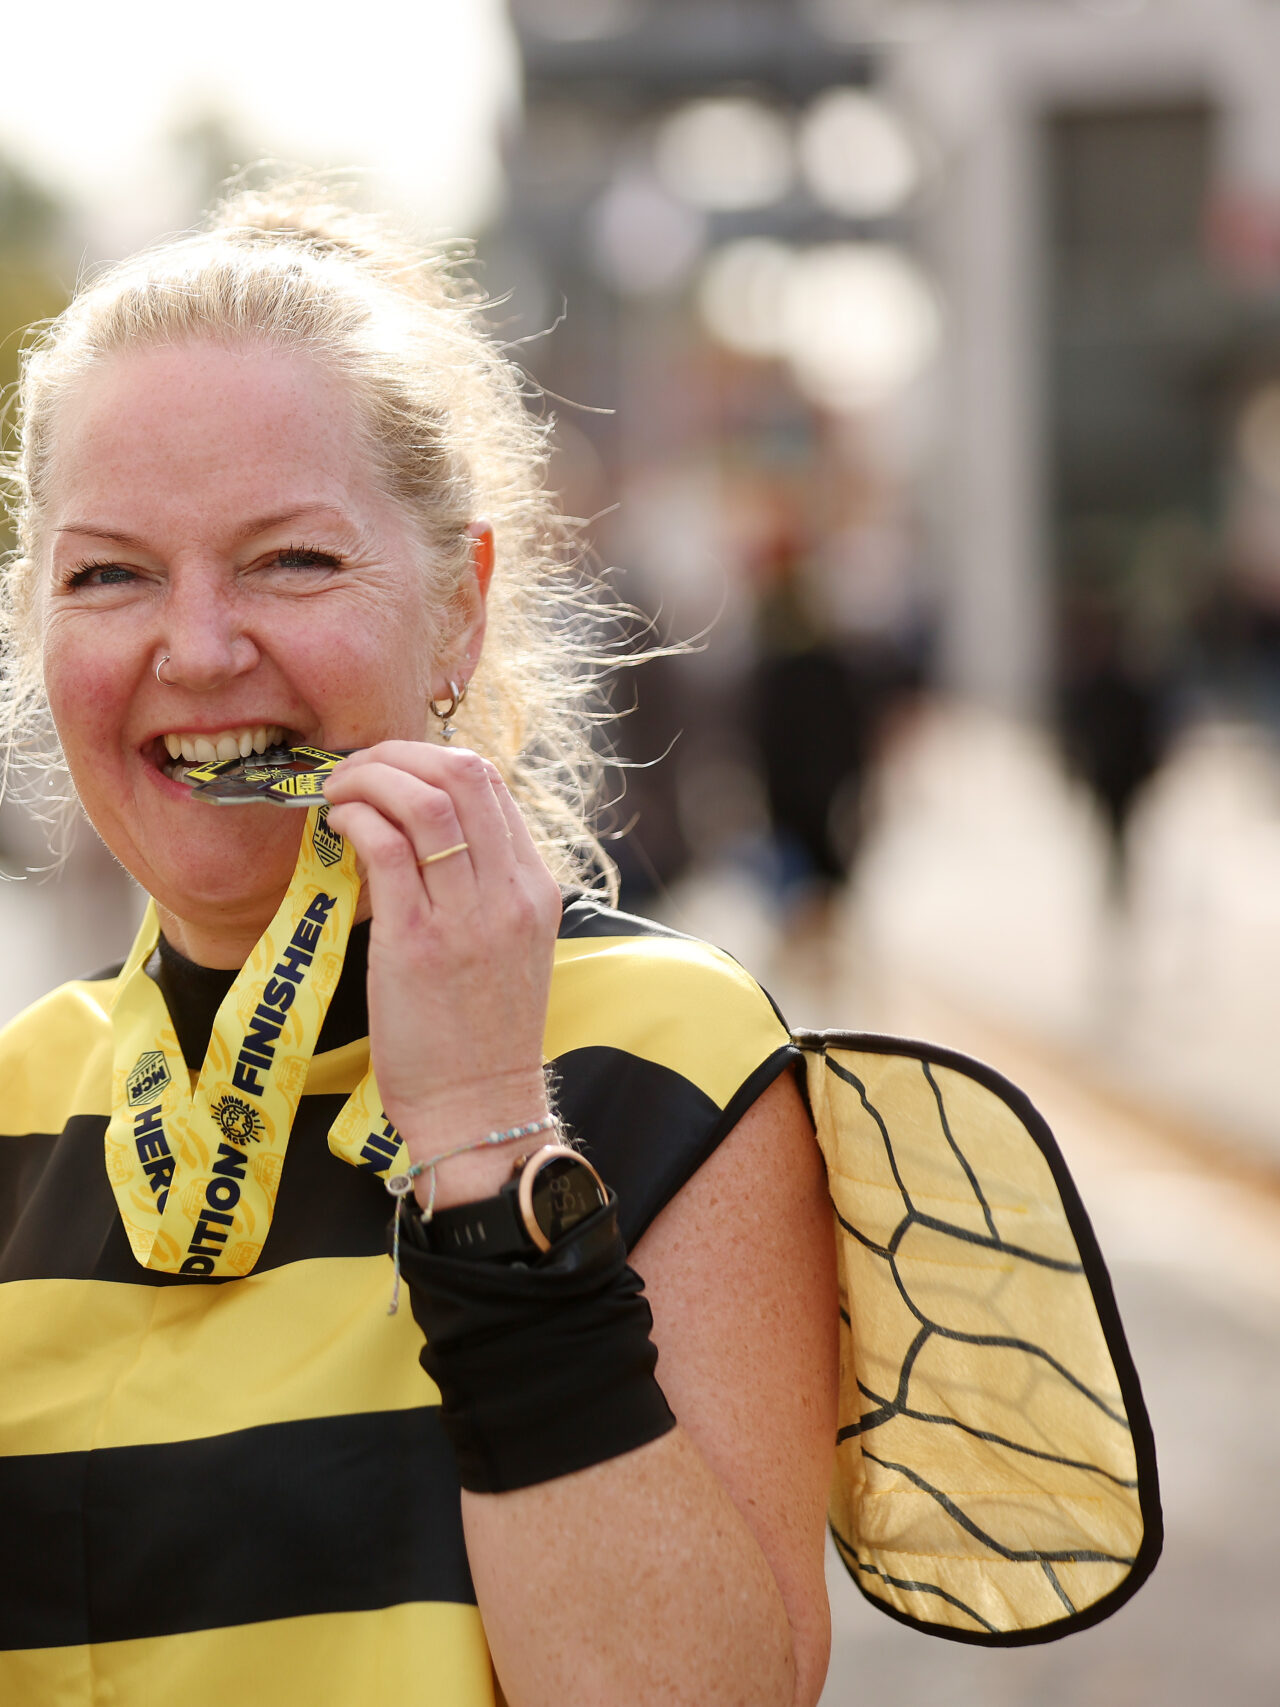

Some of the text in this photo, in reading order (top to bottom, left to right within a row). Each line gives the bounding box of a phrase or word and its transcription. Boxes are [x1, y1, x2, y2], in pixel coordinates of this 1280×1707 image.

[232, 892, 337, 1097] FINISHER
[131, 1065, 166, 1099] MCR
[221, 1095, 259, 1117] HUMAN
[133, 1104, 176, 1215] HER
[179, 1142, 248, 1276] DITION
